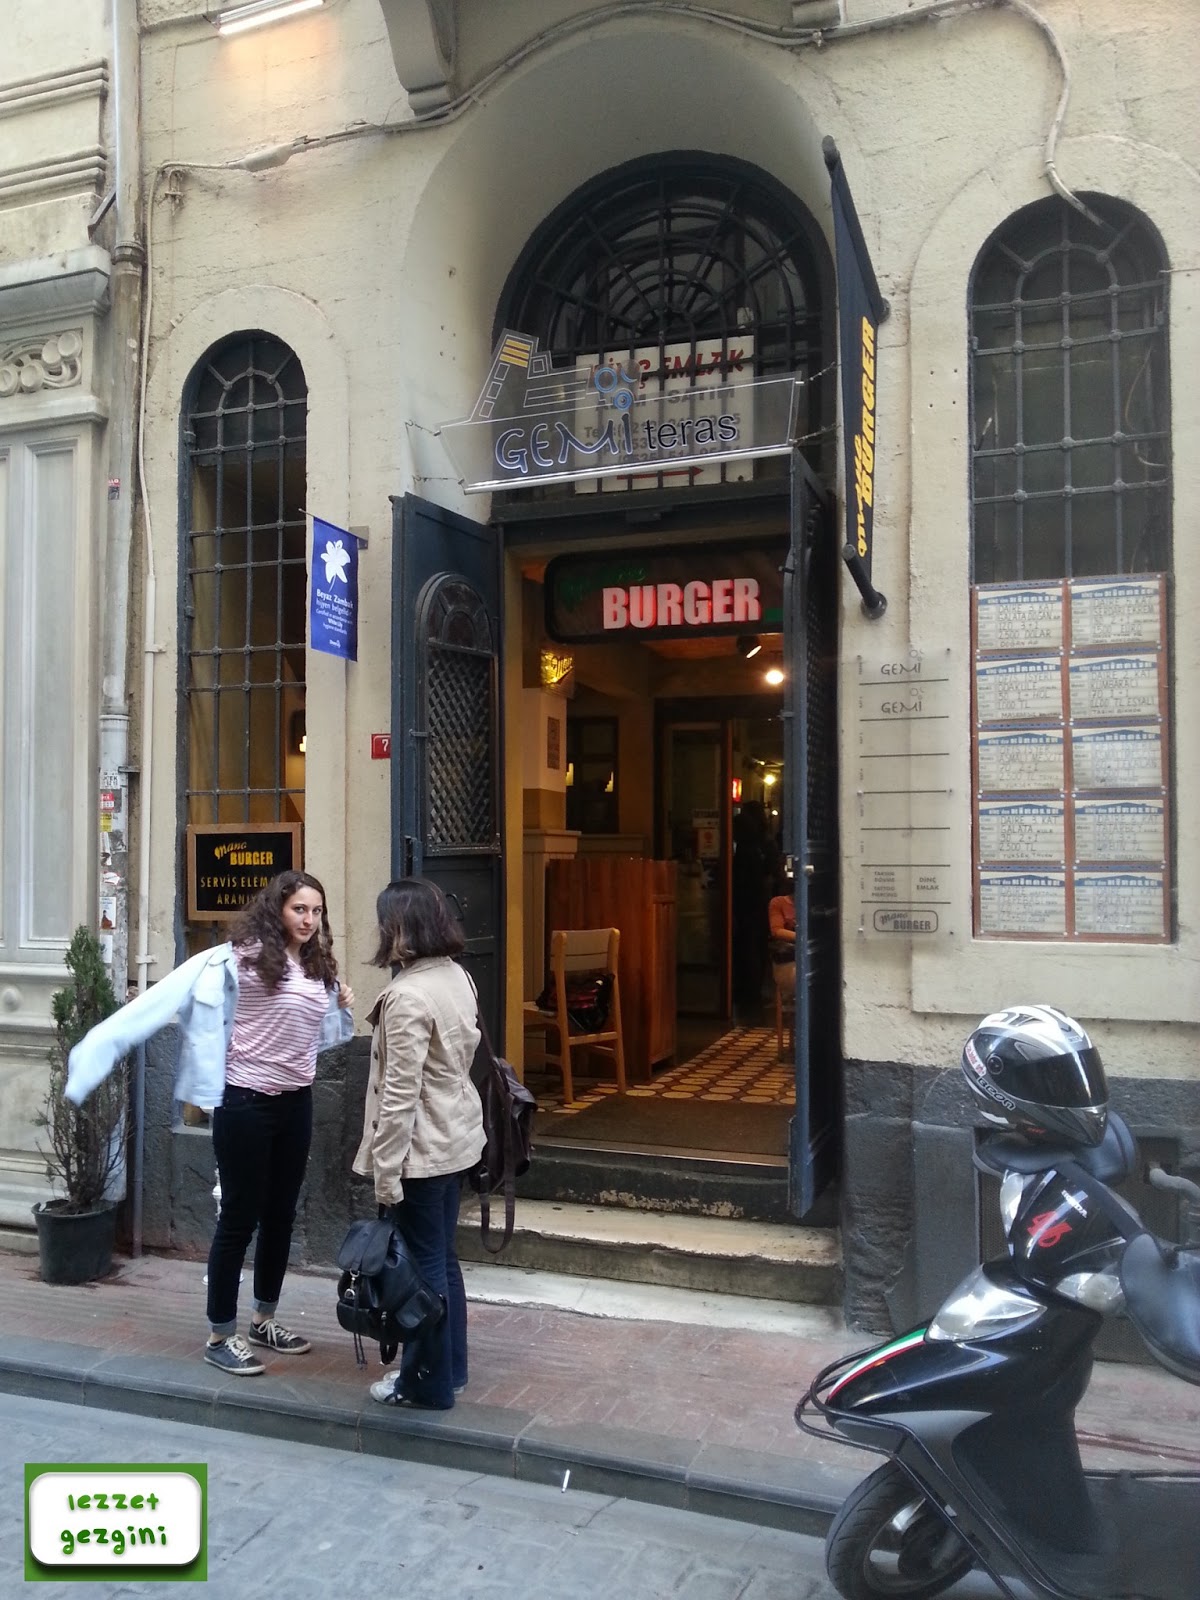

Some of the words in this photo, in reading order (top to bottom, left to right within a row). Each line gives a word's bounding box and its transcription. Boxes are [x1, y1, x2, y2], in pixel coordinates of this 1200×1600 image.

[861, 315, 875, 508] BURGER
[645, 413, 739, 451] teras
[316, 588, 332, 601] Beyaz
[602, 578, 762, 630] BURGER
[229, 851, 274, 866] BURGER
[200, 873, 237, 888] SERVİS
[893, 920, 931, 930] BURGER
[1061, 1189, 1088, 1219] HONDA
